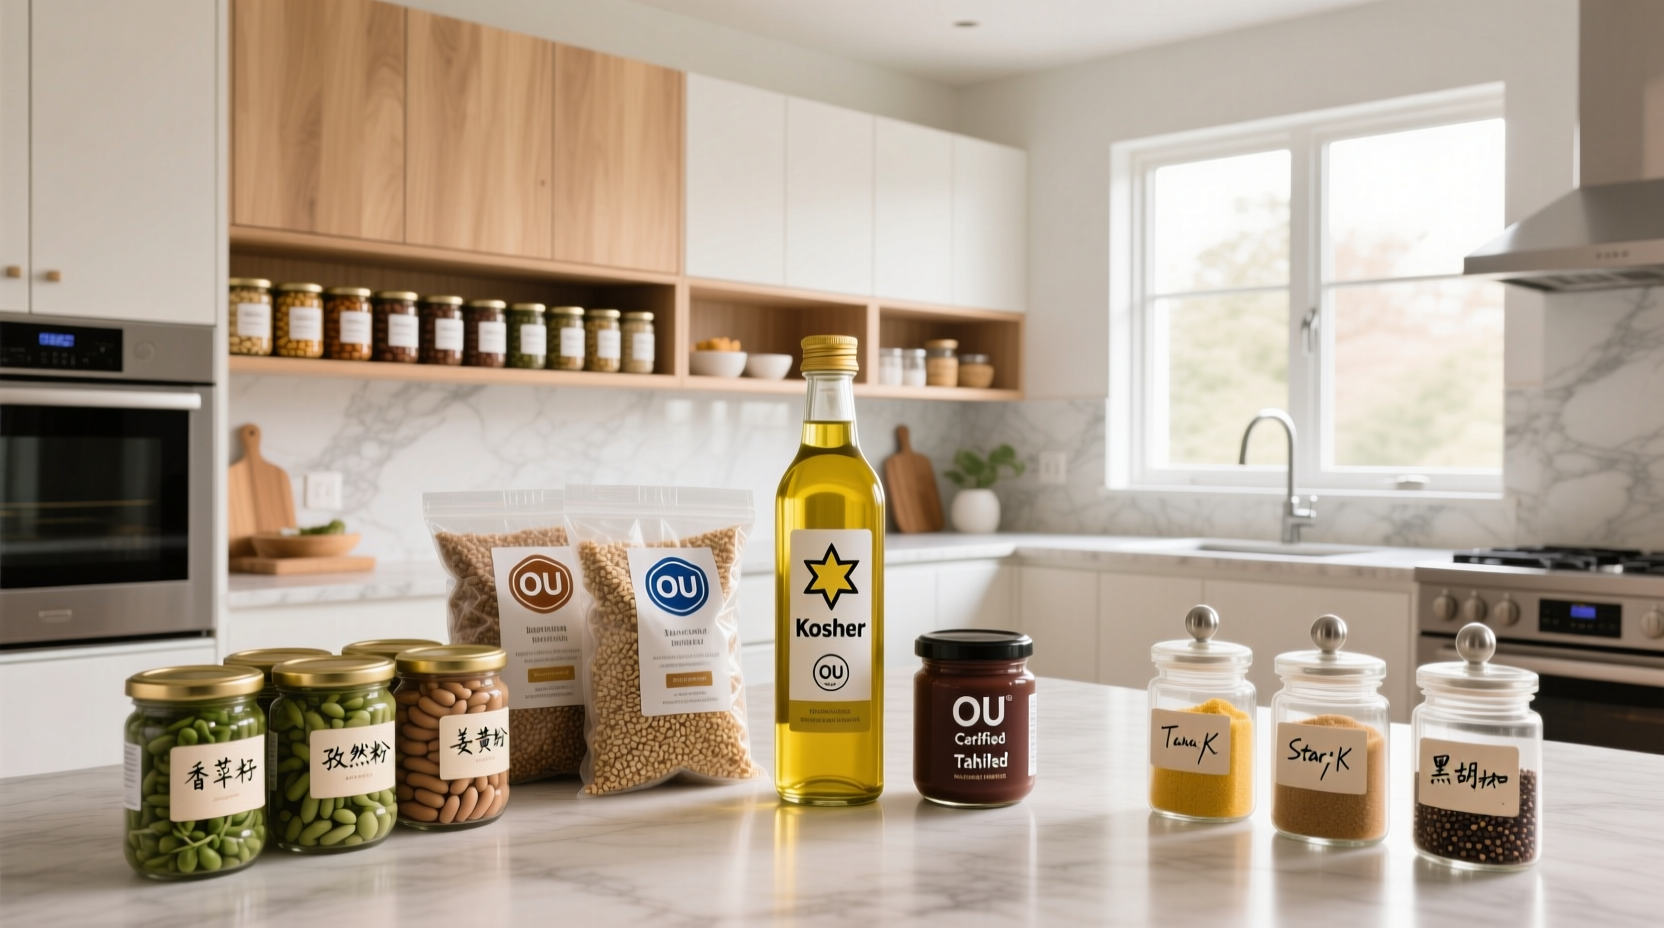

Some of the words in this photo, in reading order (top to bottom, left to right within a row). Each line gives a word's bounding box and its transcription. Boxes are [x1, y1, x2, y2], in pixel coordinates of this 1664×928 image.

[519, 571, 563, 597] OU
[656, 575, 698, 599] OU
[796, 618, 866, 638] Kosher
[819, 664, 844, 680] OU
[952, 695, 1005, 728] OU
